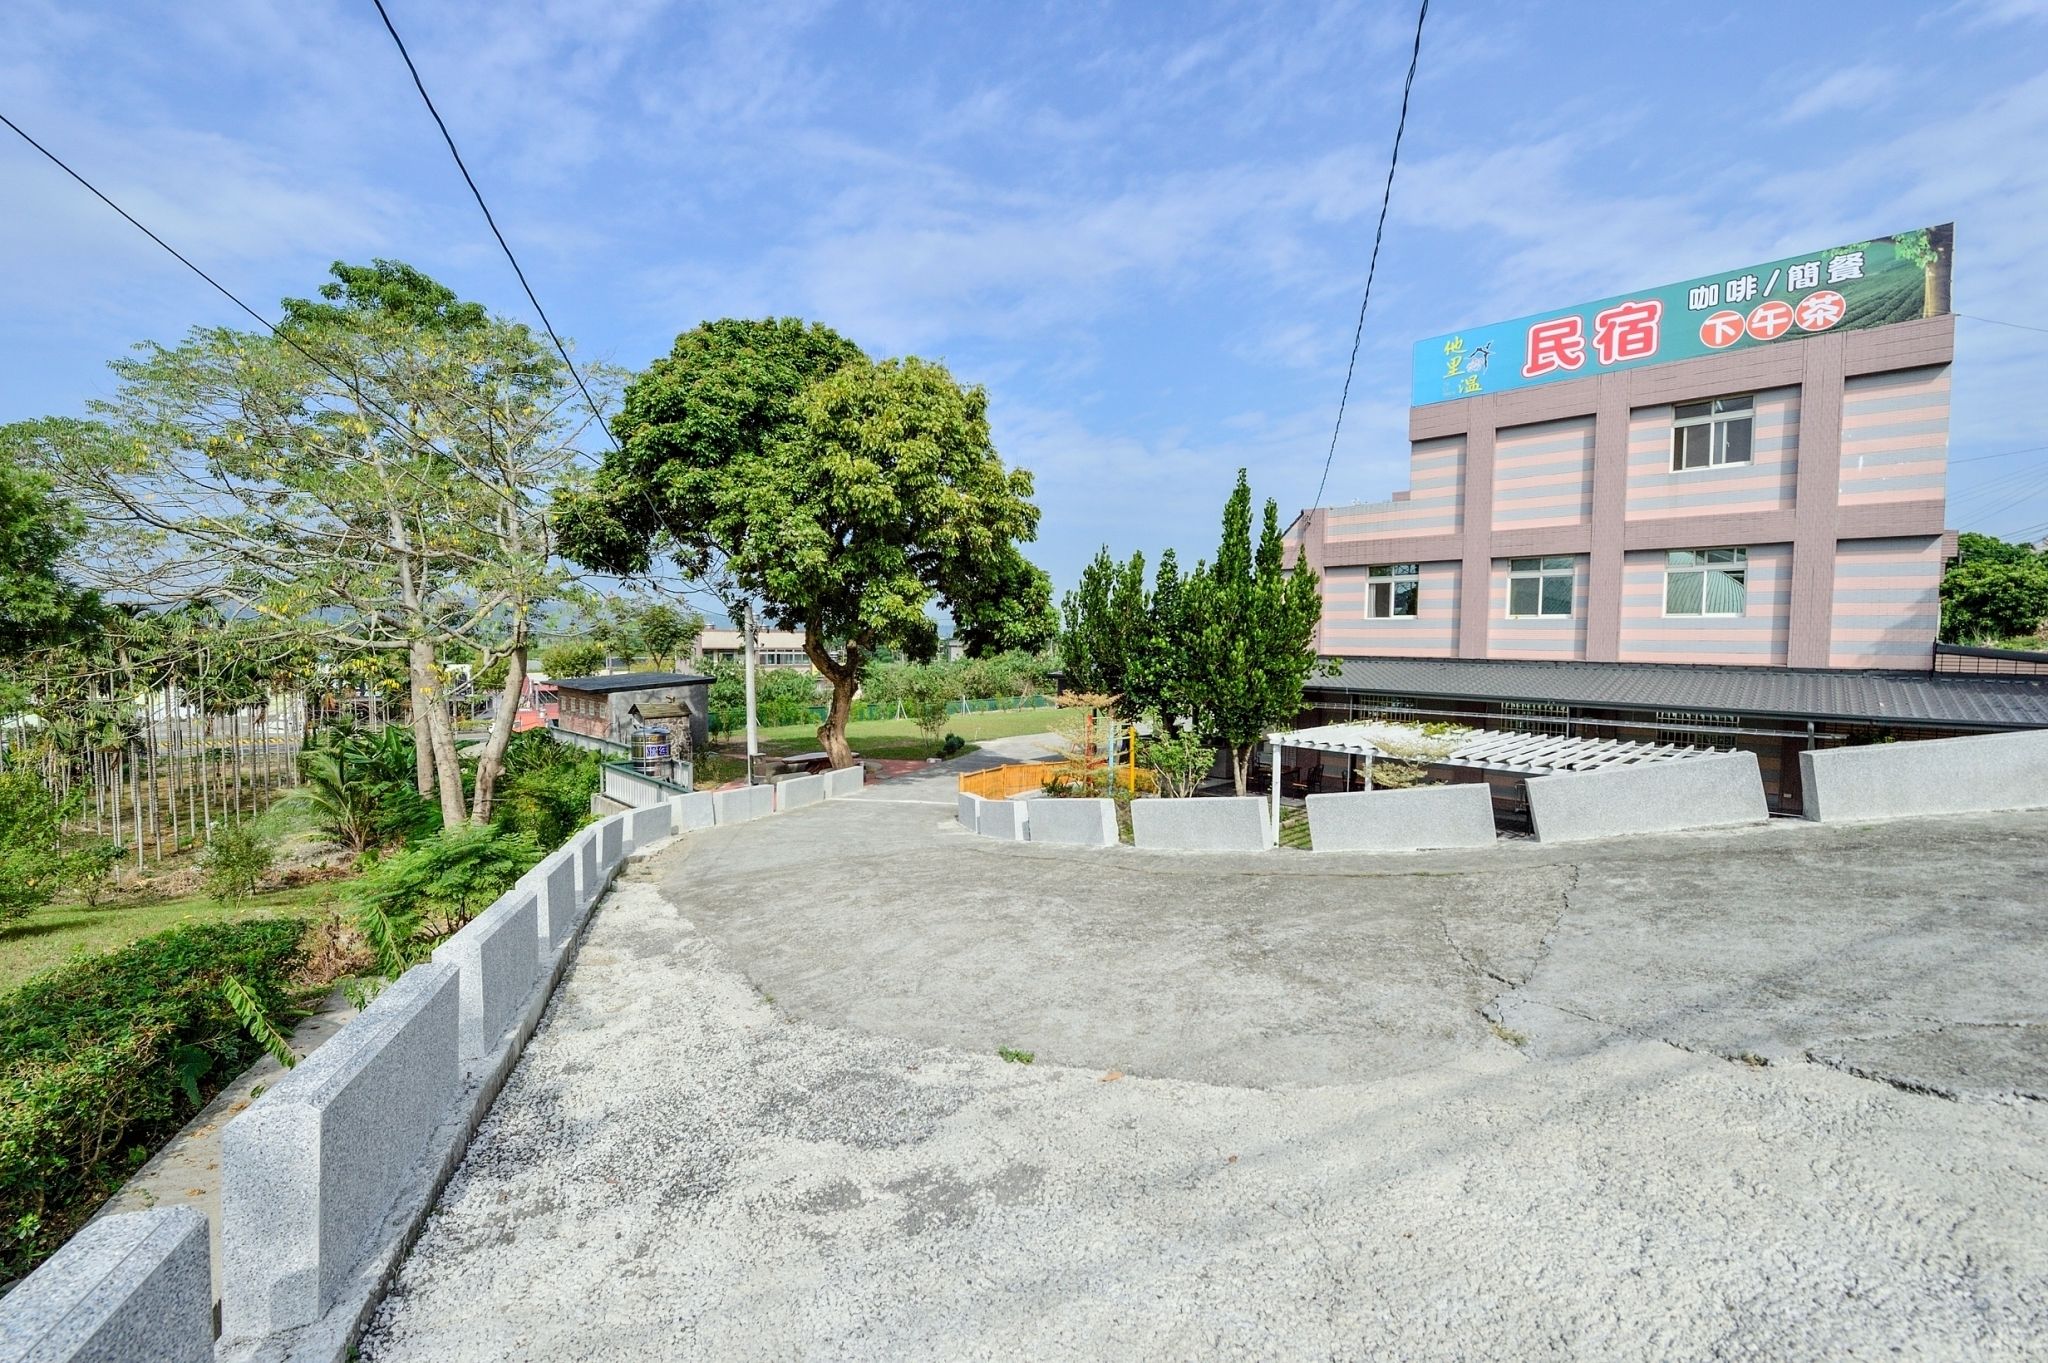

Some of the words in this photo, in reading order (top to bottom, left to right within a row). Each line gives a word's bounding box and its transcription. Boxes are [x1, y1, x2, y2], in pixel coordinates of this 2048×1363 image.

[1689, 251, 1865, 311] 咖啡/簡餐
[1522, 300, 1662, 377] 民宿
[1704, 293, 1841, 345] 下午茶
